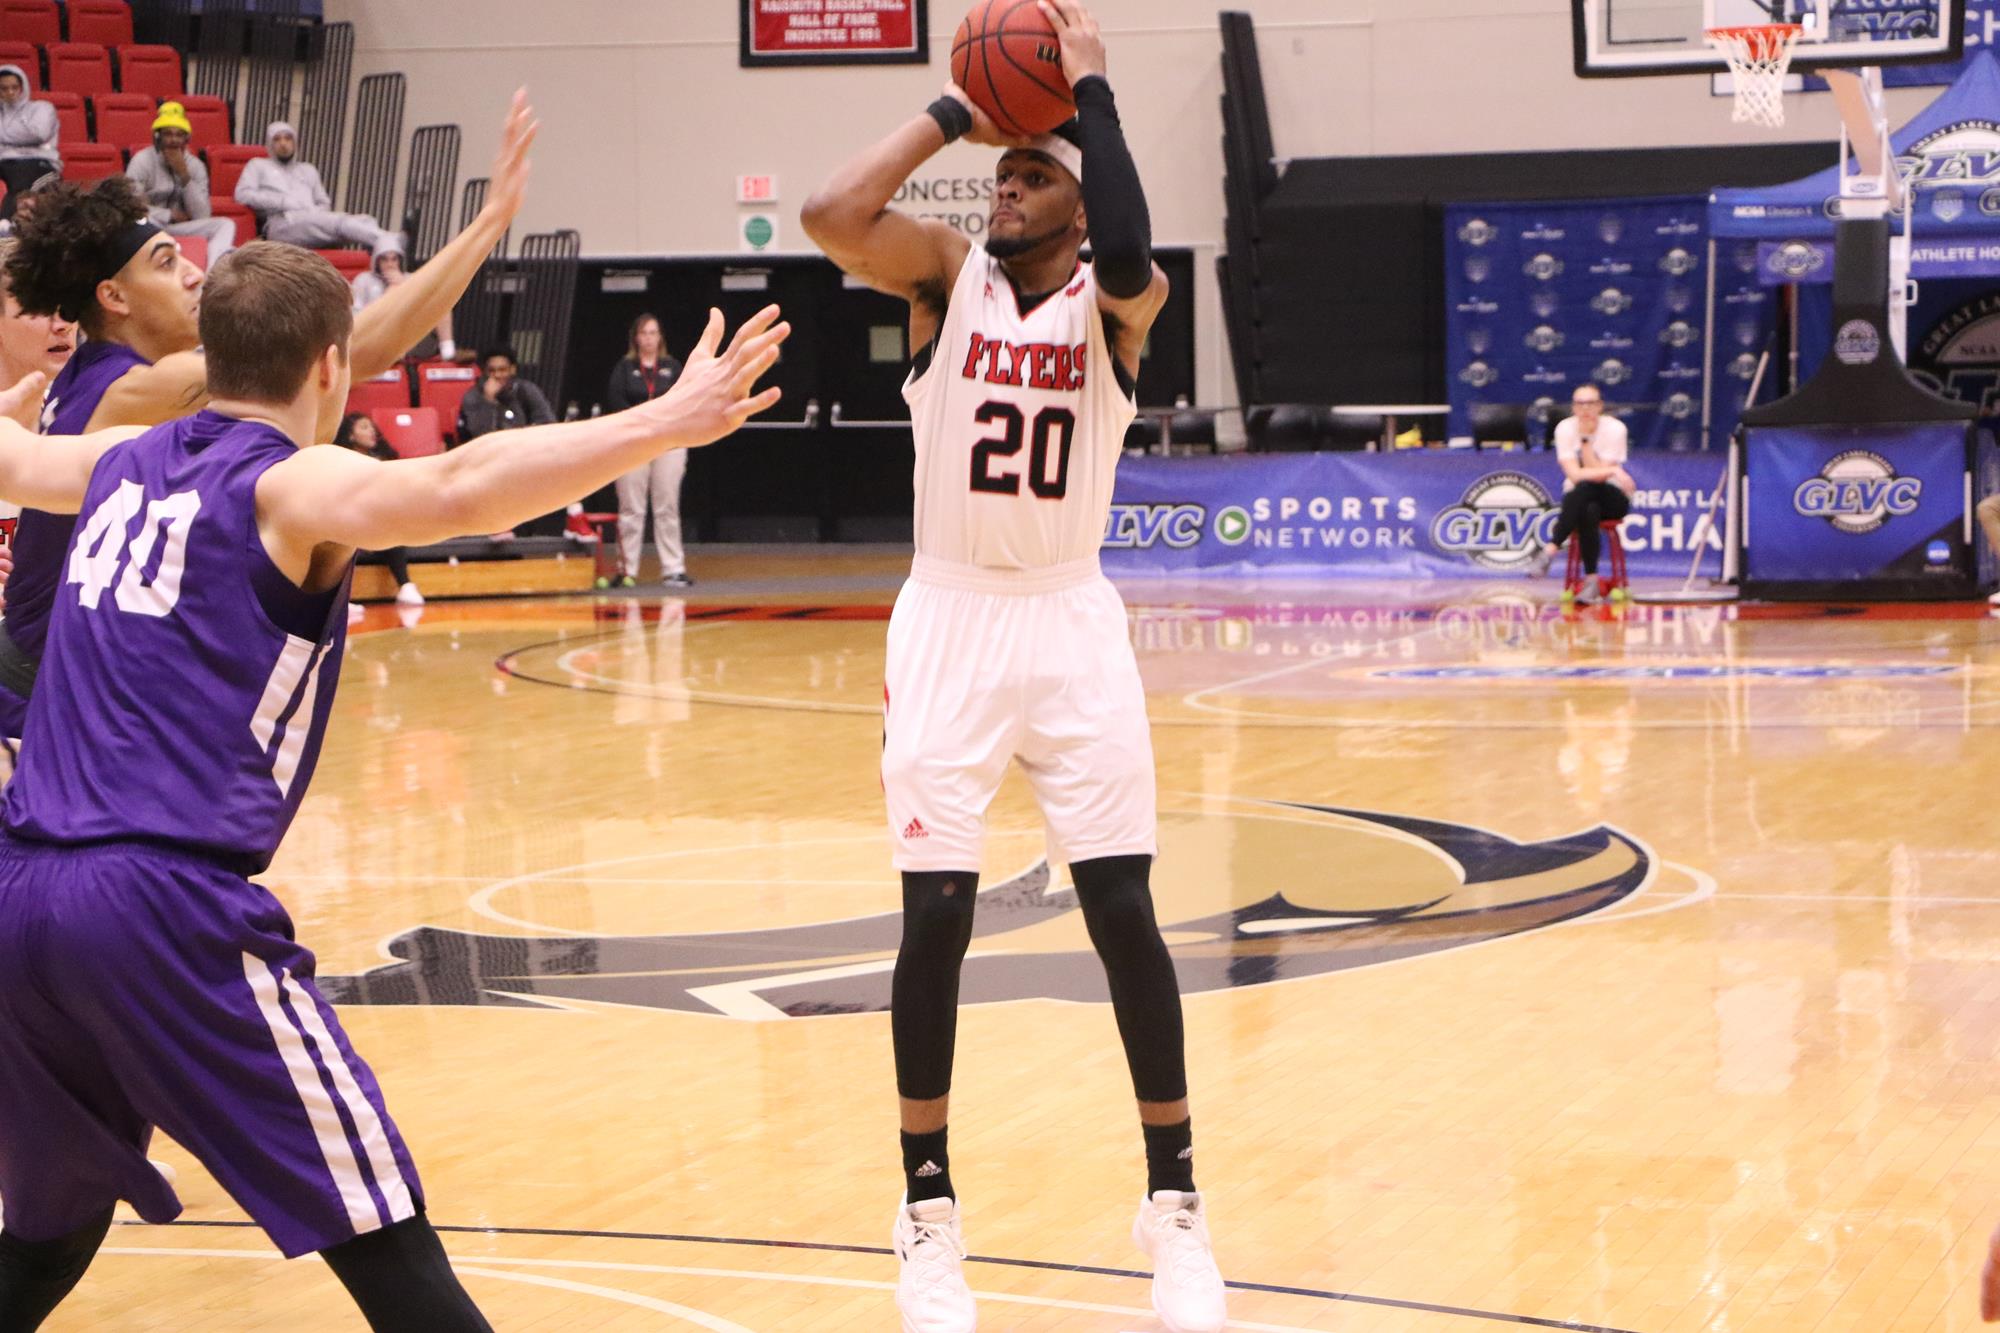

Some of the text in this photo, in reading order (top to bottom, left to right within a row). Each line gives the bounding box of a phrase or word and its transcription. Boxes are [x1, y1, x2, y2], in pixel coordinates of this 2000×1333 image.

[789, 12, 879, 27] HALL OF FAME
[962, 332, 1087, 391] FLYERS
[970, 400, 1076, 500] 20
[1253, 497, 1417, 521] SPORTS
[1632, 489, 1692, 508] REAT
[1794, 477, 1922, 517] GLVC
[66, 478, 202, 618] 40
[1254, 526, 1416, 549] NETWORK
[1619, 513, 1724, 551] CHA
